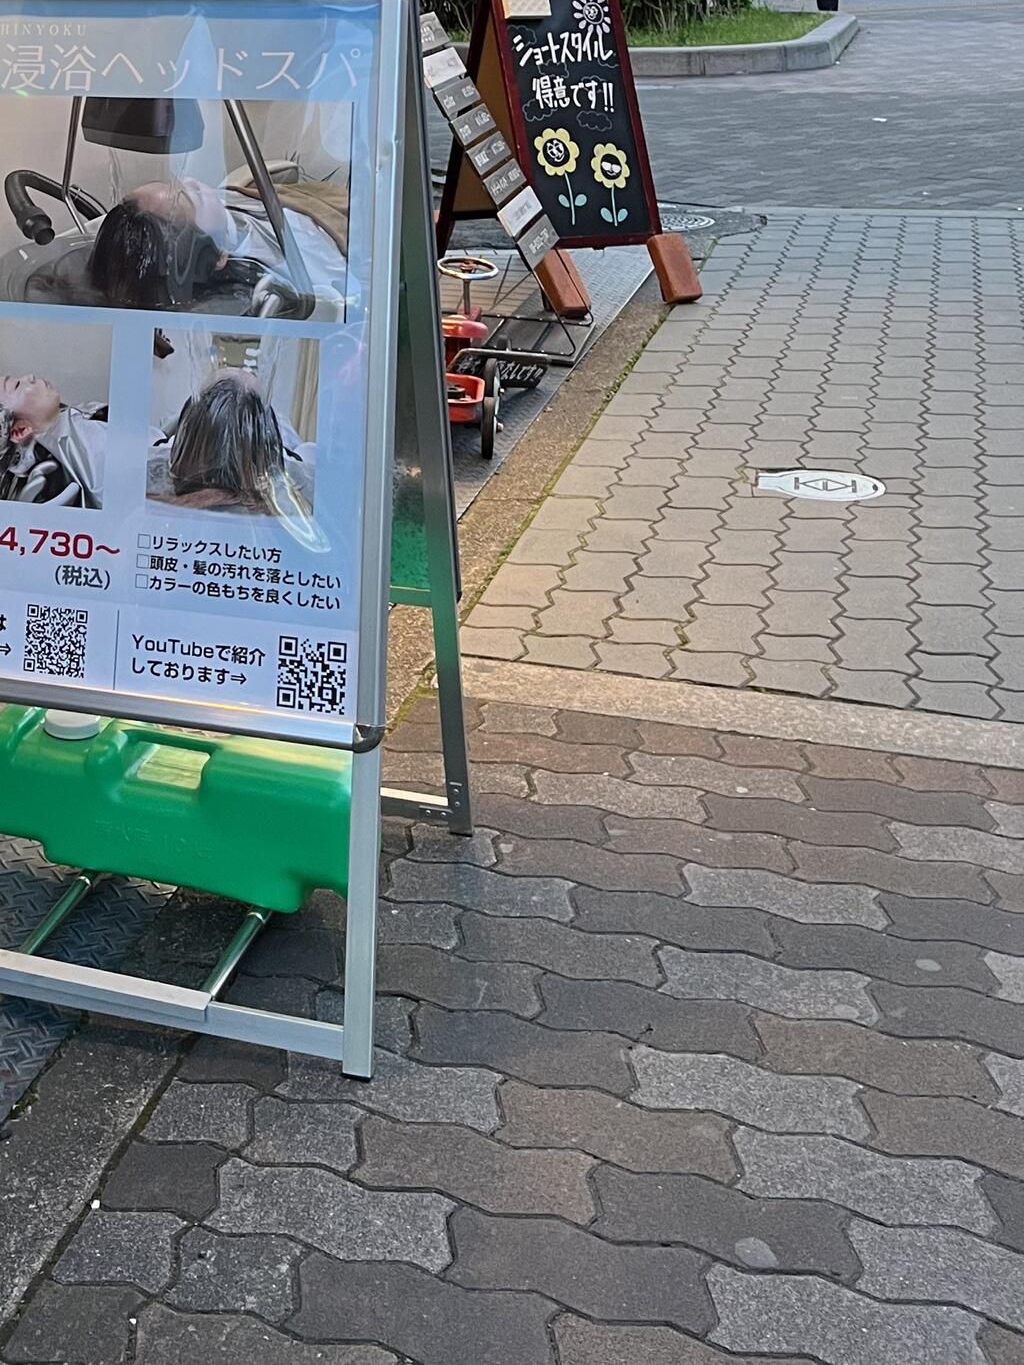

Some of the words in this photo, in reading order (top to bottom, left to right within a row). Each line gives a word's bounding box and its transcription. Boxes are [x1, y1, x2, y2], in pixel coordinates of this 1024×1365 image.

[511, 31, 615, 67] ショートスタイル
[53, 565, 112, 591] (税込)
[131, 634, 266, 669] YouTubeで紹介
